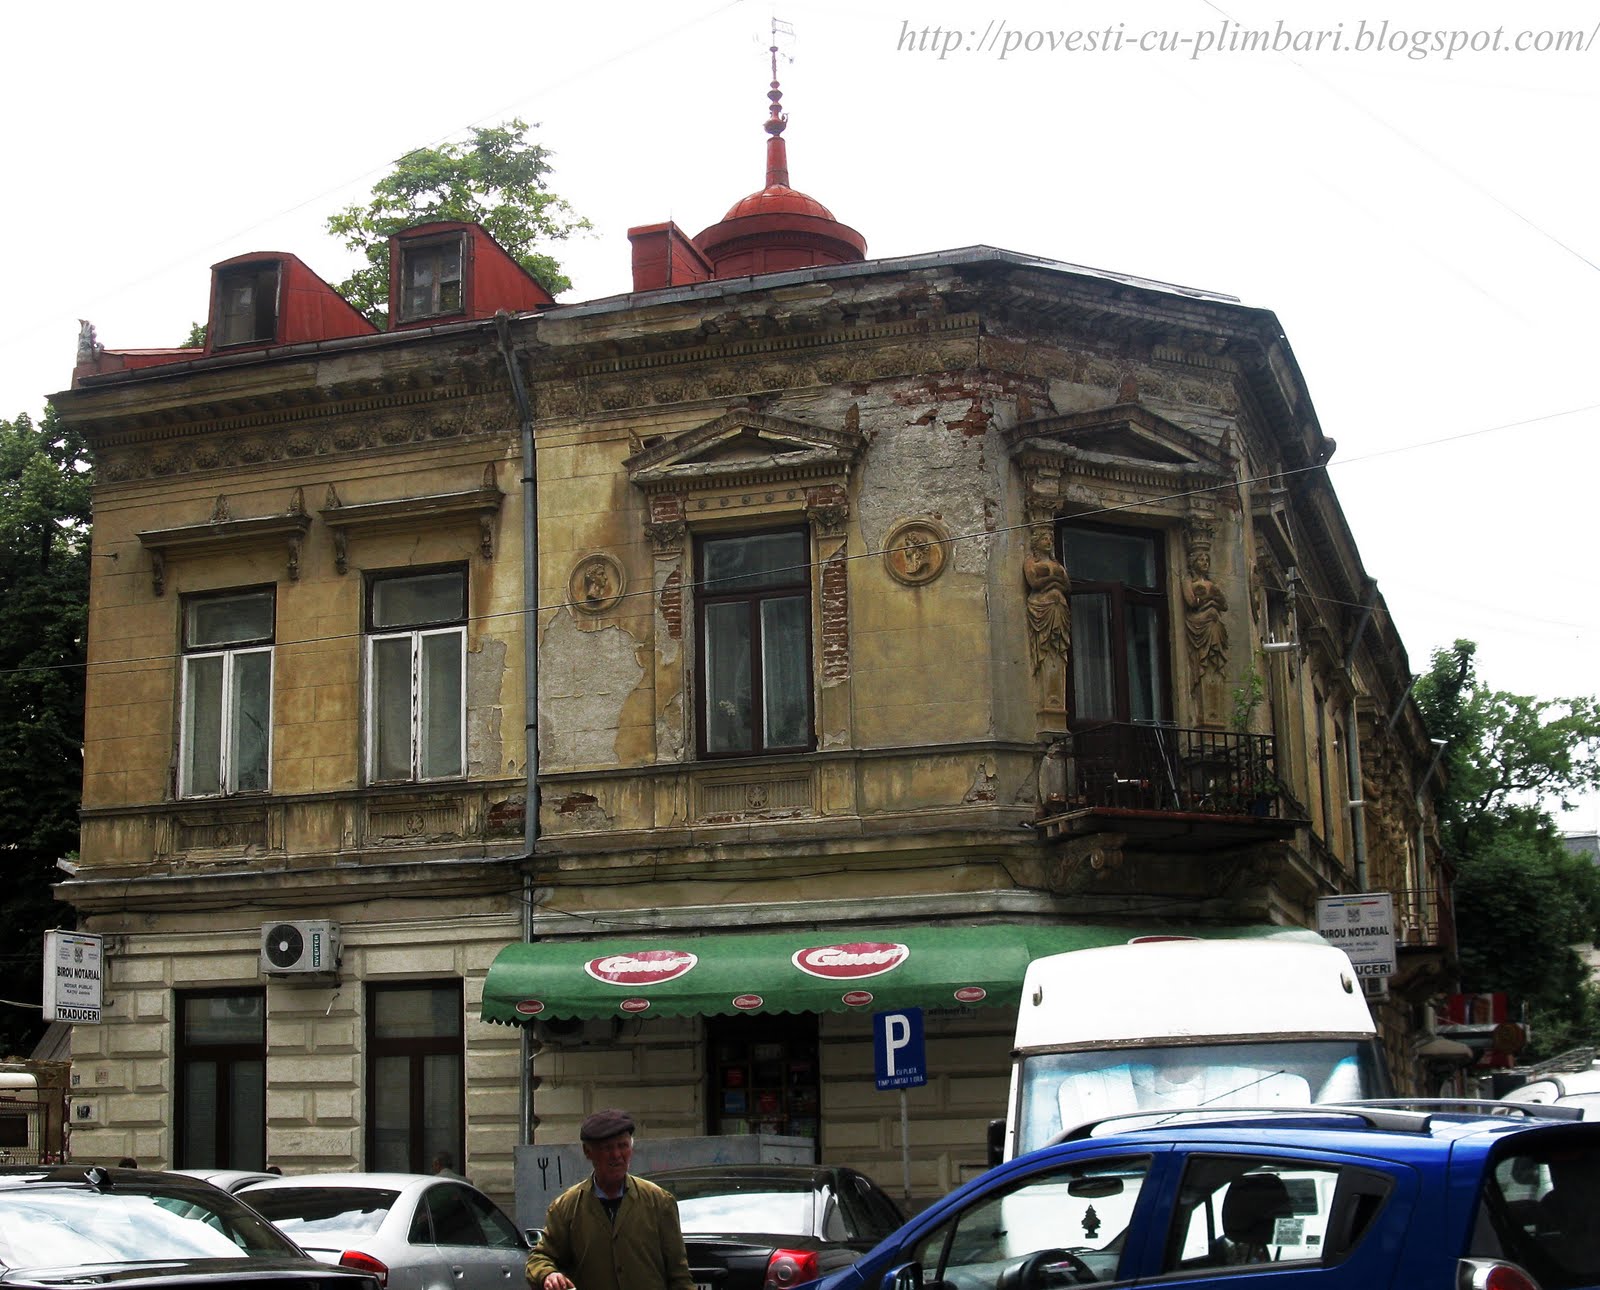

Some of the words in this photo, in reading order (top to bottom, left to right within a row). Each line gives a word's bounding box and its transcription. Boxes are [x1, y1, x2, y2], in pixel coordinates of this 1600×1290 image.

[1320, 928, 1346, 939] BIROU
[1348, 926, 1389, 937] NOTARIAL
[57, 966, 74, 978] BIROU
[75, 968, 100, 980] NOTARIAL
[1355, 964, 1391, 975] UCERI
[58, 1008, 100, 1021] TRADUCERI
[885, 1014, 911, 1077] P
